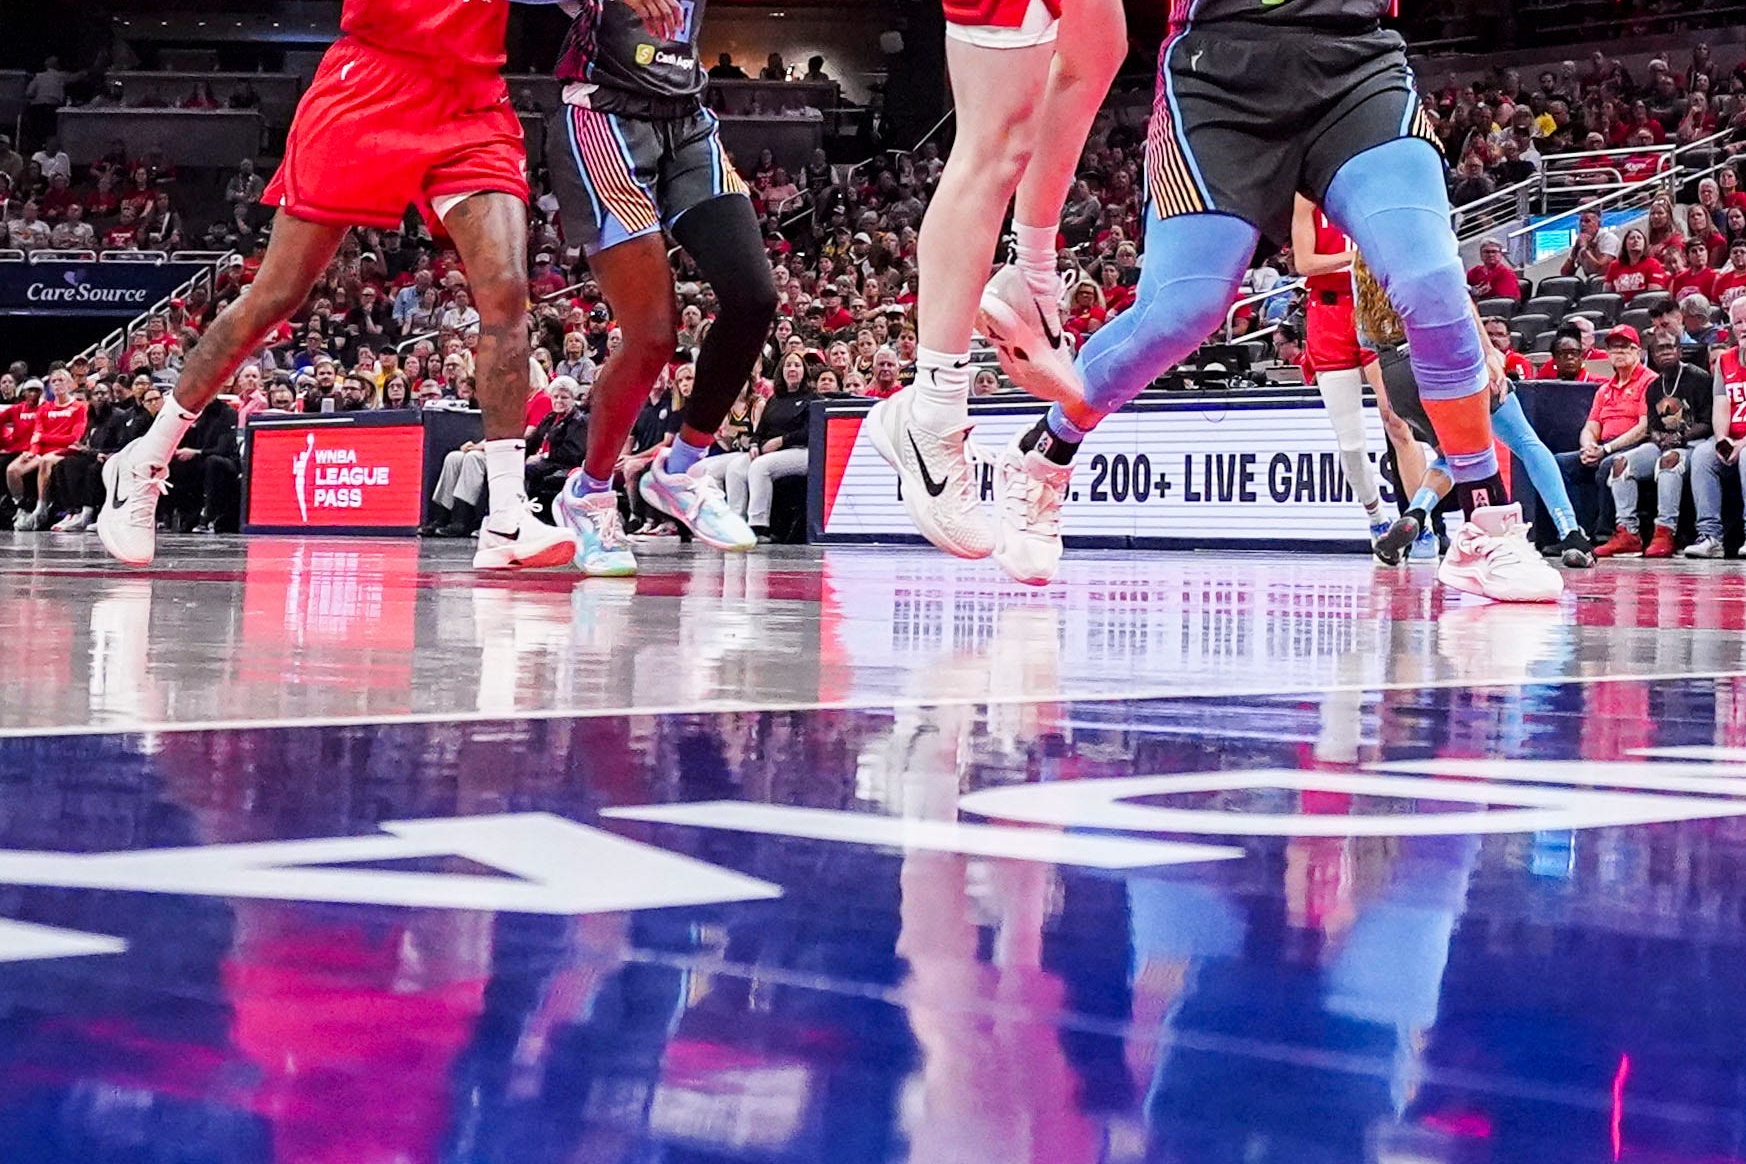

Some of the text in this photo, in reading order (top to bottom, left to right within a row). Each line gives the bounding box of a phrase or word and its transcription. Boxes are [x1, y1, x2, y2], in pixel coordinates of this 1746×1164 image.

[27, 282, 146, 303] CareSource
[315, 449, 357, 464] WNBA
[314, 466, 390, 486] LEAGUE
[1090, 453, 1172, 503] 200+
[1184, 452, 1257, 504] LIVE
[1267, 452, 1398, 504] GAMS
[313, 487, 363, 508] PASS
